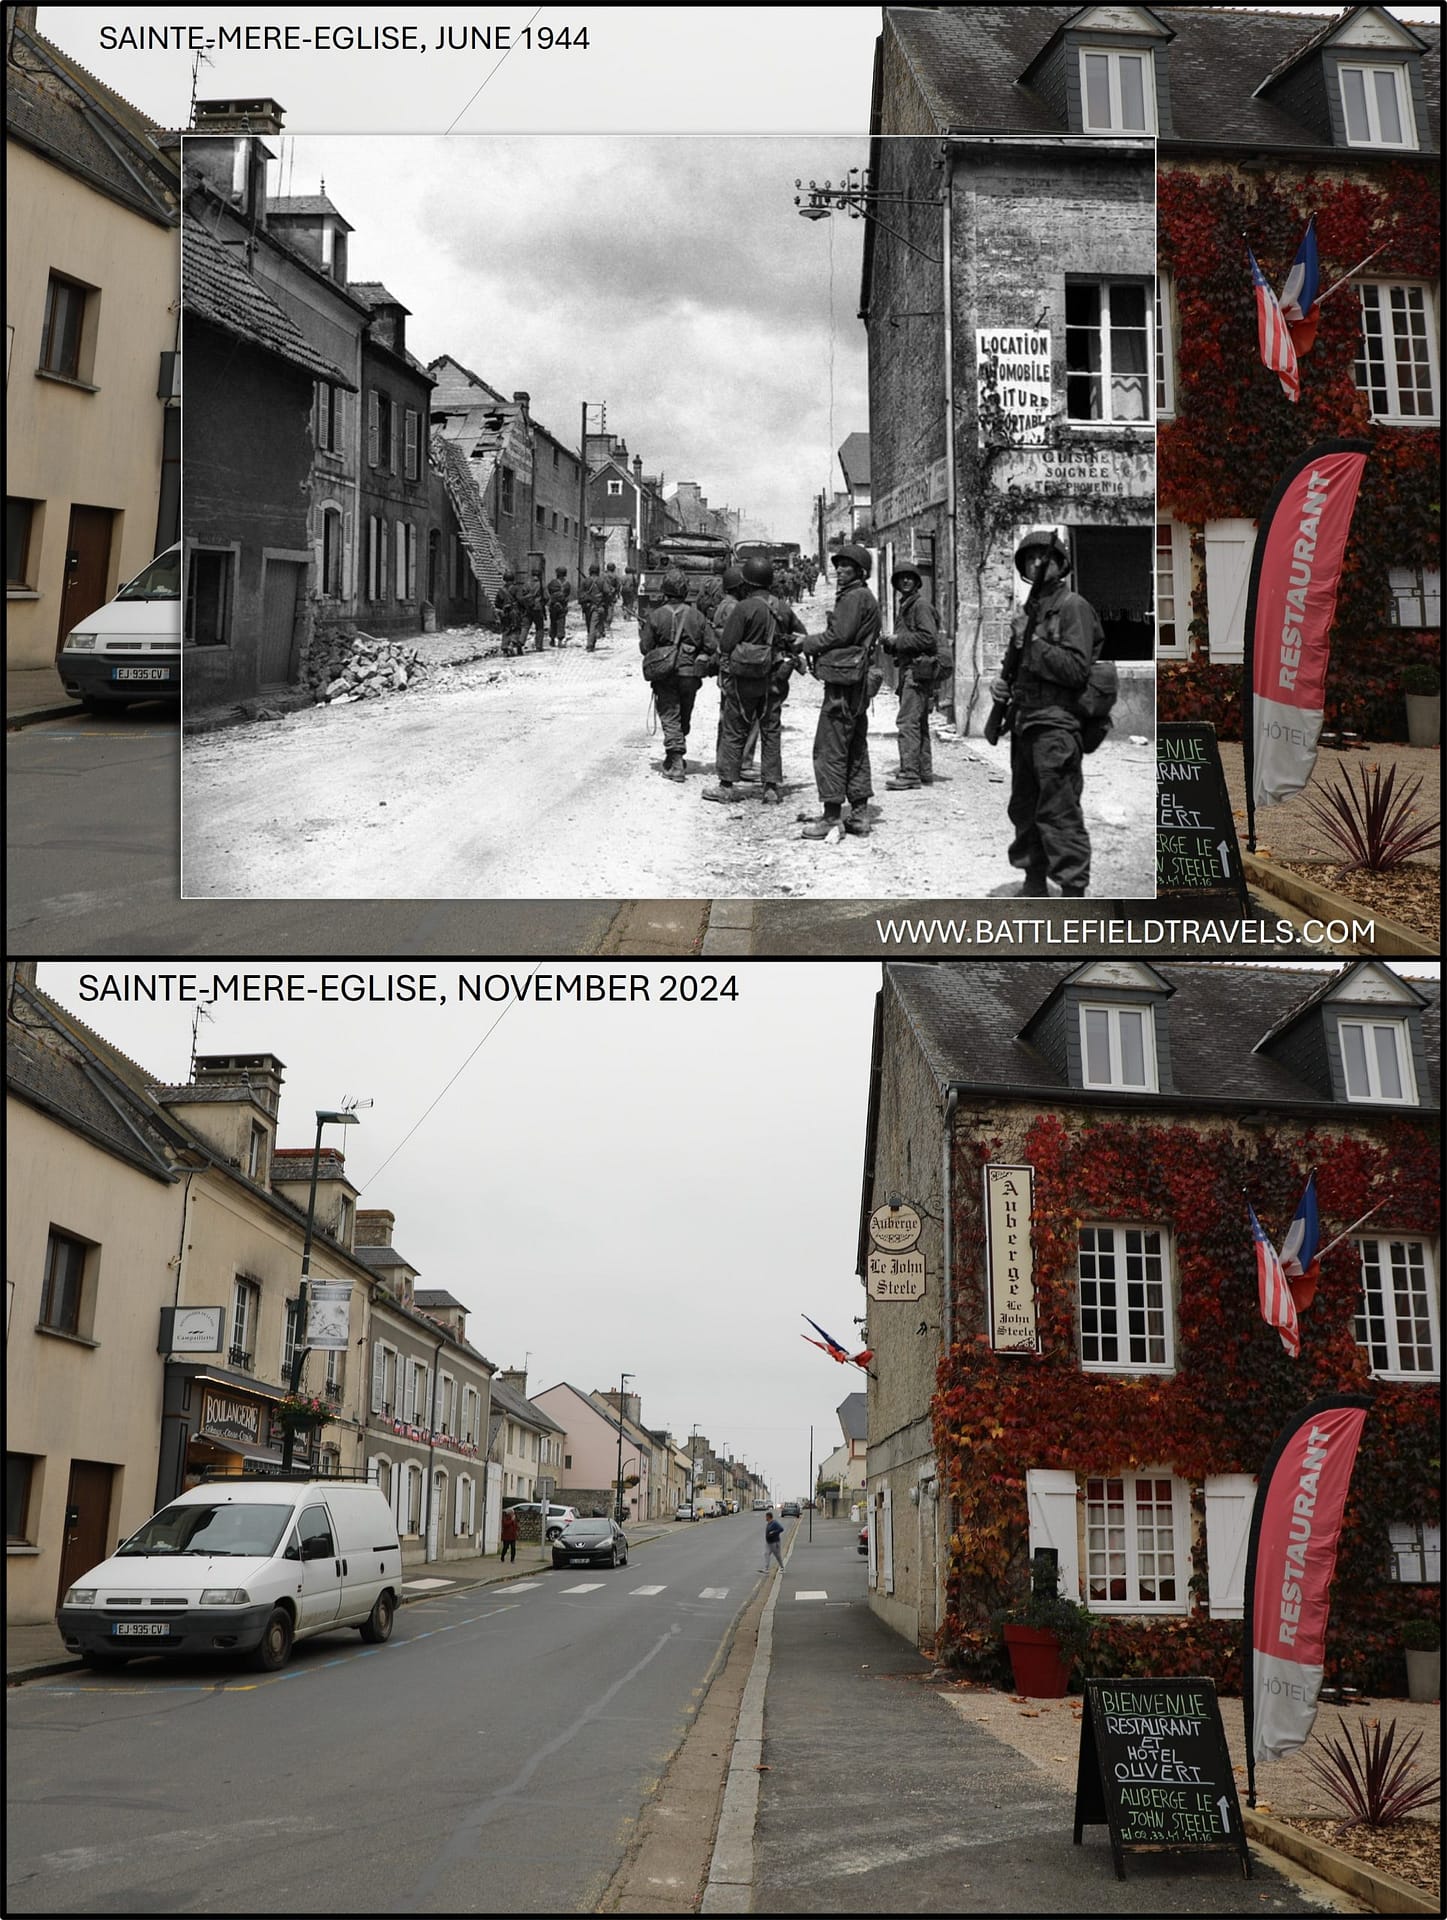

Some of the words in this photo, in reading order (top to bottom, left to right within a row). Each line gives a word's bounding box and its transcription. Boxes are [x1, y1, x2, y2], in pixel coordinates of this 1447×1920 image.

[1279, 470, 1331, 691] RESTAURANT
[1196, 837, 1213, 857] LE
[1172, 856, 1222, 878] STEELE
[871, 1216, 918, 1232] Auberge
[1002, 1180, 1021, 1296] Auberge
[870, 1258, 887, 1275] Le
[890, 1258, 923, 1276] John
[876, 1280, 917, 1295] Steele
[1007, 1301, 1022, 1311] Le
[999, 1313, 1030, 1324] John
[997, 1326, 1034, 1337] Steele
[206, 1395, 258, 1433] BOULANGERIE
[1279, 1425, 1331, 1646] RESTAURANT
[1102, 1690, 1207, 1716] BIENVENUE
[1106, 1716, 1201, 1736] RESTAURANT
[1141, 1736, 1164, 1749] ET
[1114, 1762, 1201, 1783] OUVERT
[1120, 1787, 1188, 1810] AUBERGE
[1197, 1792, 1213, 1812] LE
[1128, 1810, 1164, 1828] JOHN
[1171, 1813, 1221, 1833] STEELE
